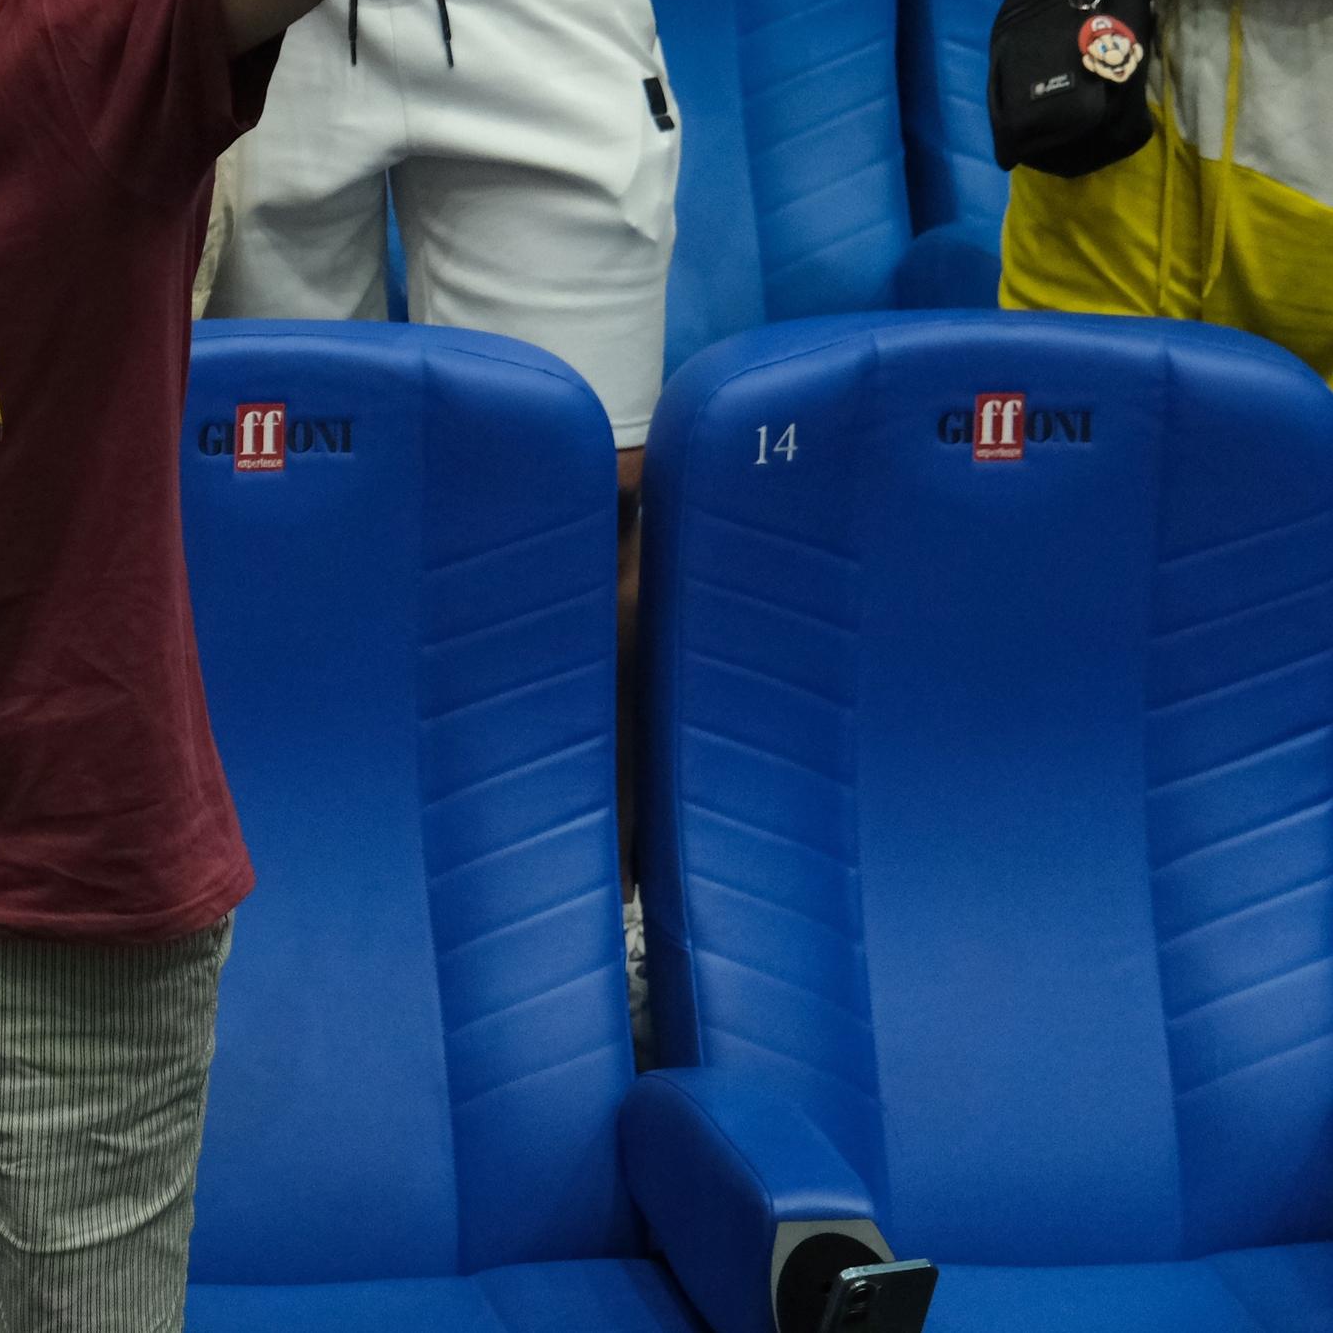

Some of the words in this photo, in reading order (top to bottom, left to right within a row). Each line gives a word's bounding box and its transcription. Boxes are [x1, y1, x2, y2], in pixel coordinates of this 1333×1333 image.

[198, 409, 354, 456] GIffONI
[754, 422, 798, 465] 14
[938, 399, 1091, 445] GIffONI
[237, 457, 283, 469] experience
